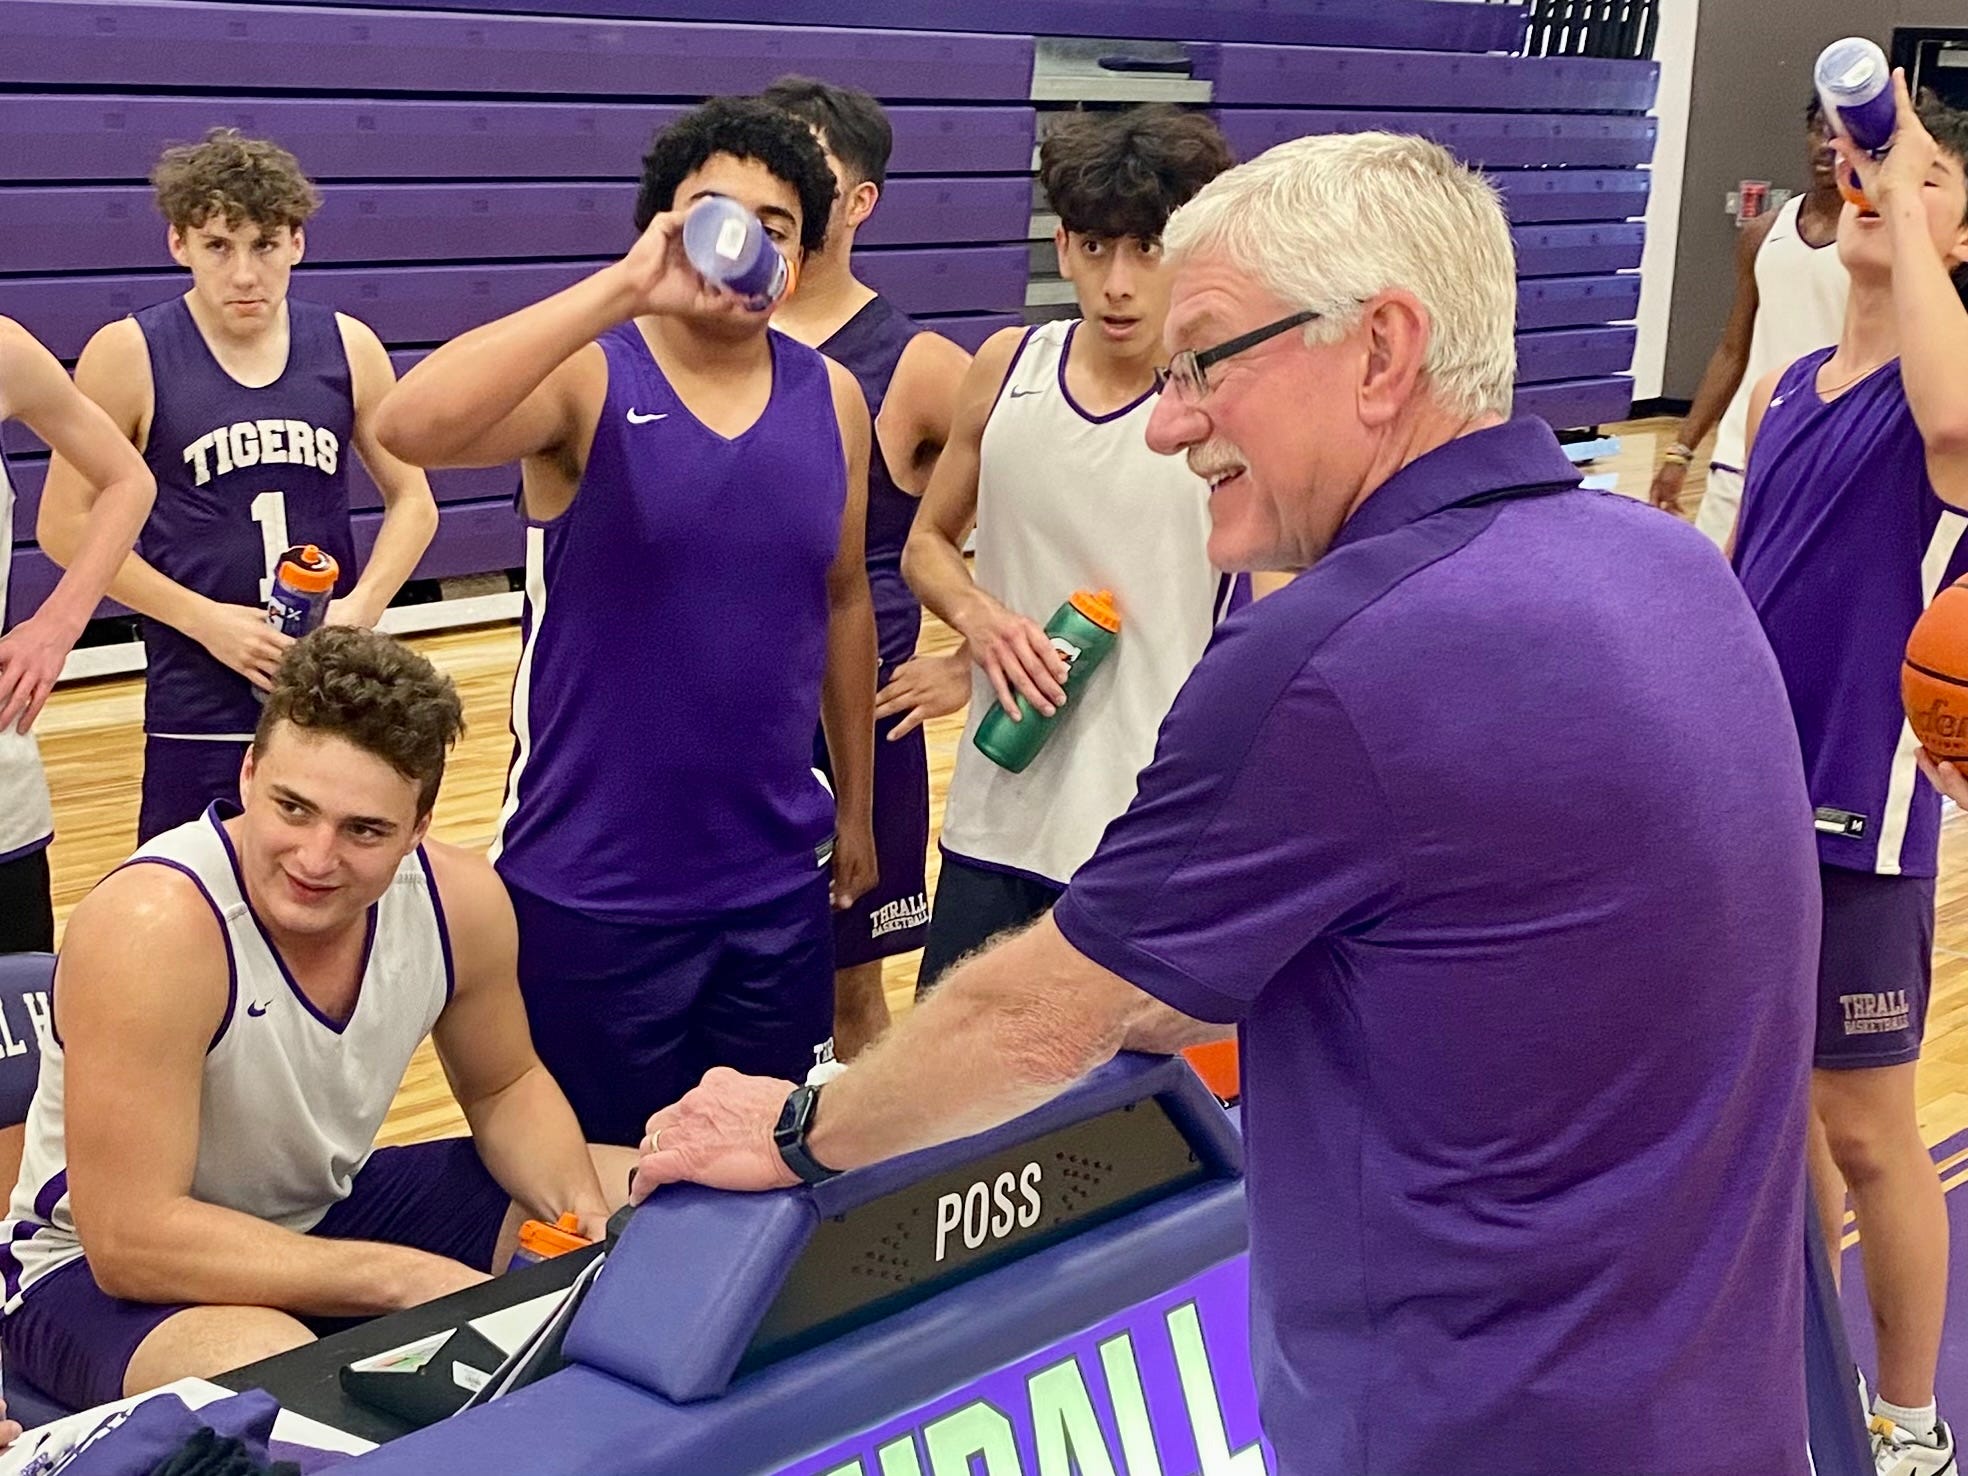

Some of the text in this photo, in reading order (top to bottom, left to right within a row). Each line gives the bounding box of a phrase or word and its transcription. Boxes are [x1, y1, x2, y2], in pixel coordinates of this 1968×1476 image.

[182, 419, 339, 487] TIGERS
[250, 491, 291, 603] 1
[869, 892, 927, 928] THRALL
[1839, 989, 1909, 1020] THRALL
[936, 1162, 1042, 1262] POSS
